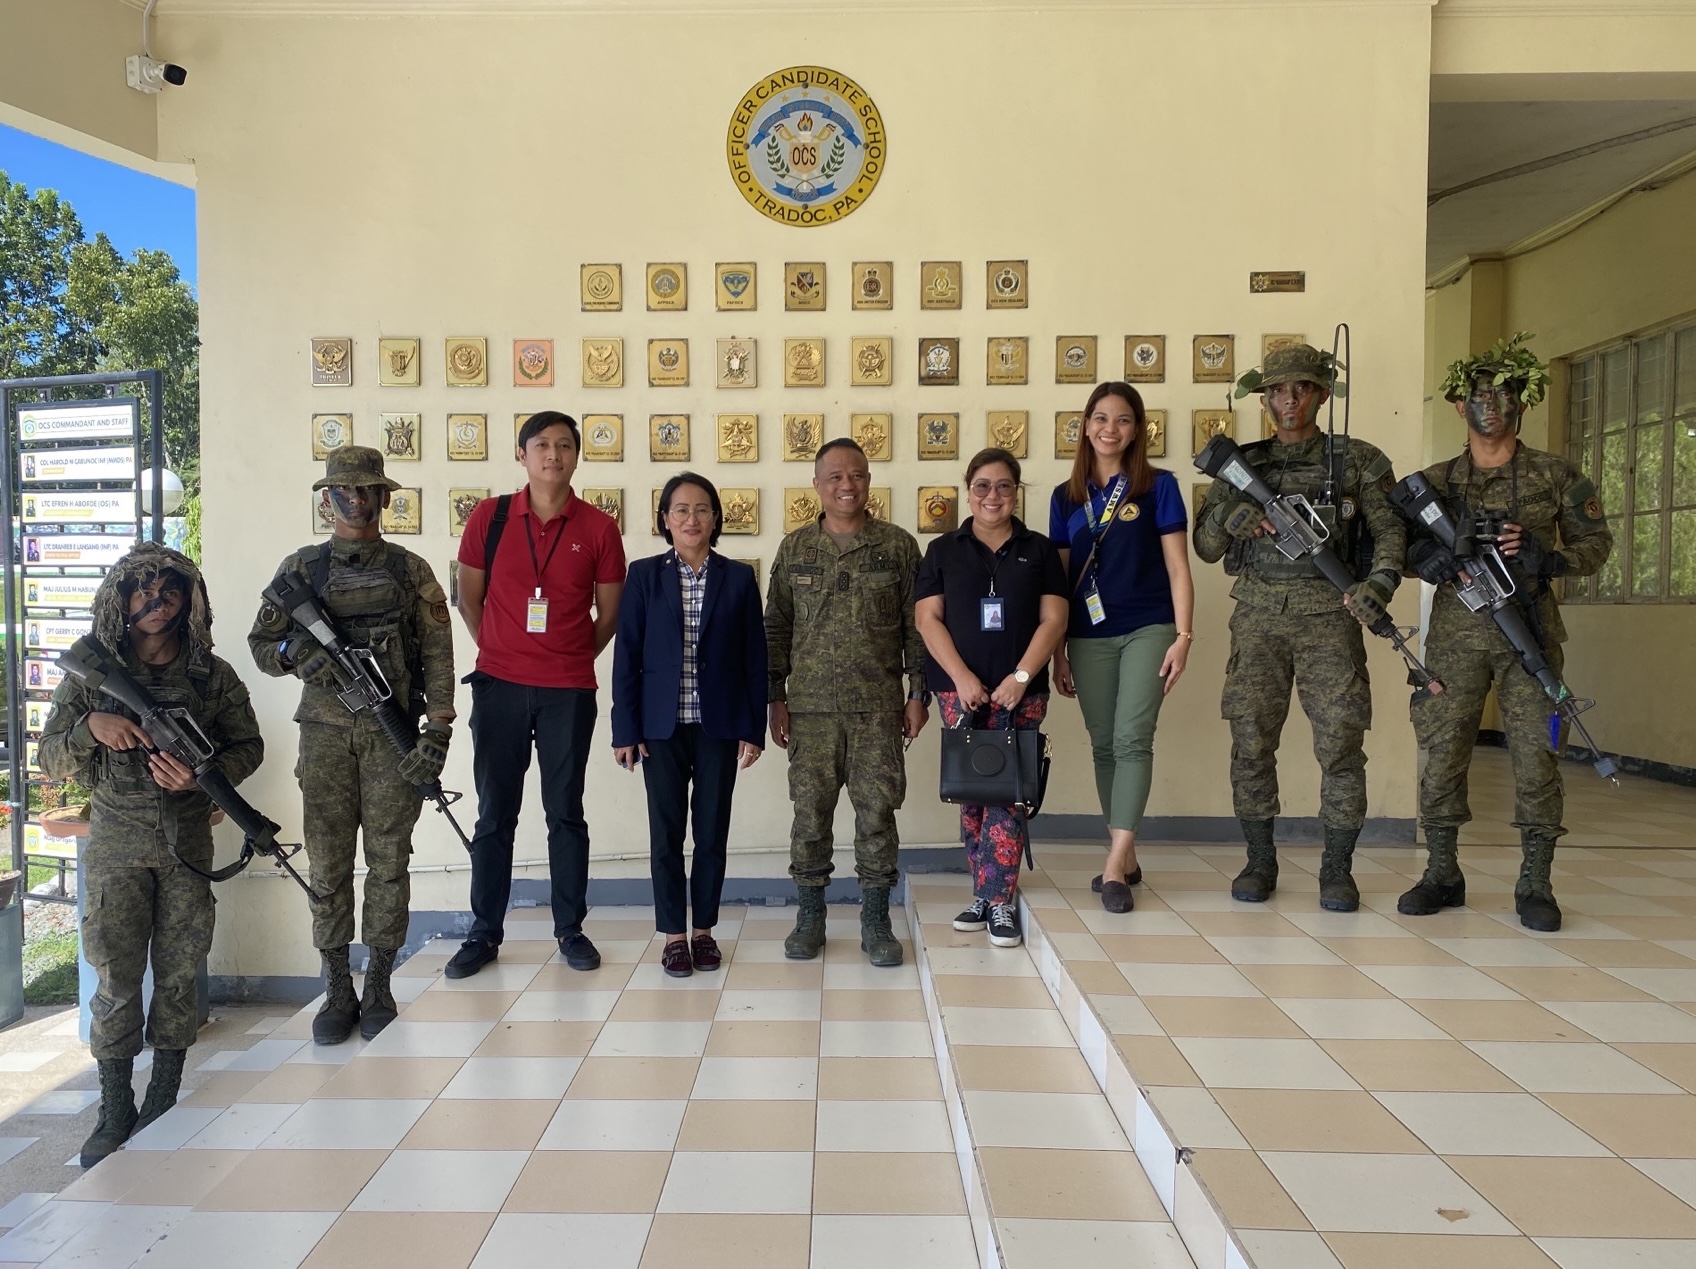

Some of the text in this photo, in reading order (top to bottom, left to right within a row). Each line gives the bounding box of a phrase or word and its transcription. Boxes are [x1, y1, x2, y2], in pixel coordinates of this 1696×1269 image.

[731, 70, 882, 185] OFFICER CANDIDATE SCHOOL
[792, 146, 817, 166] OCS
[752, 190, 858, 224] TRADOC, PA
[38, 417, 129, 430] OCS COMMANDANT AND STAFF
[54, 585, 71, 593] JULIUS
[46, 627, 54, 635] CPT
